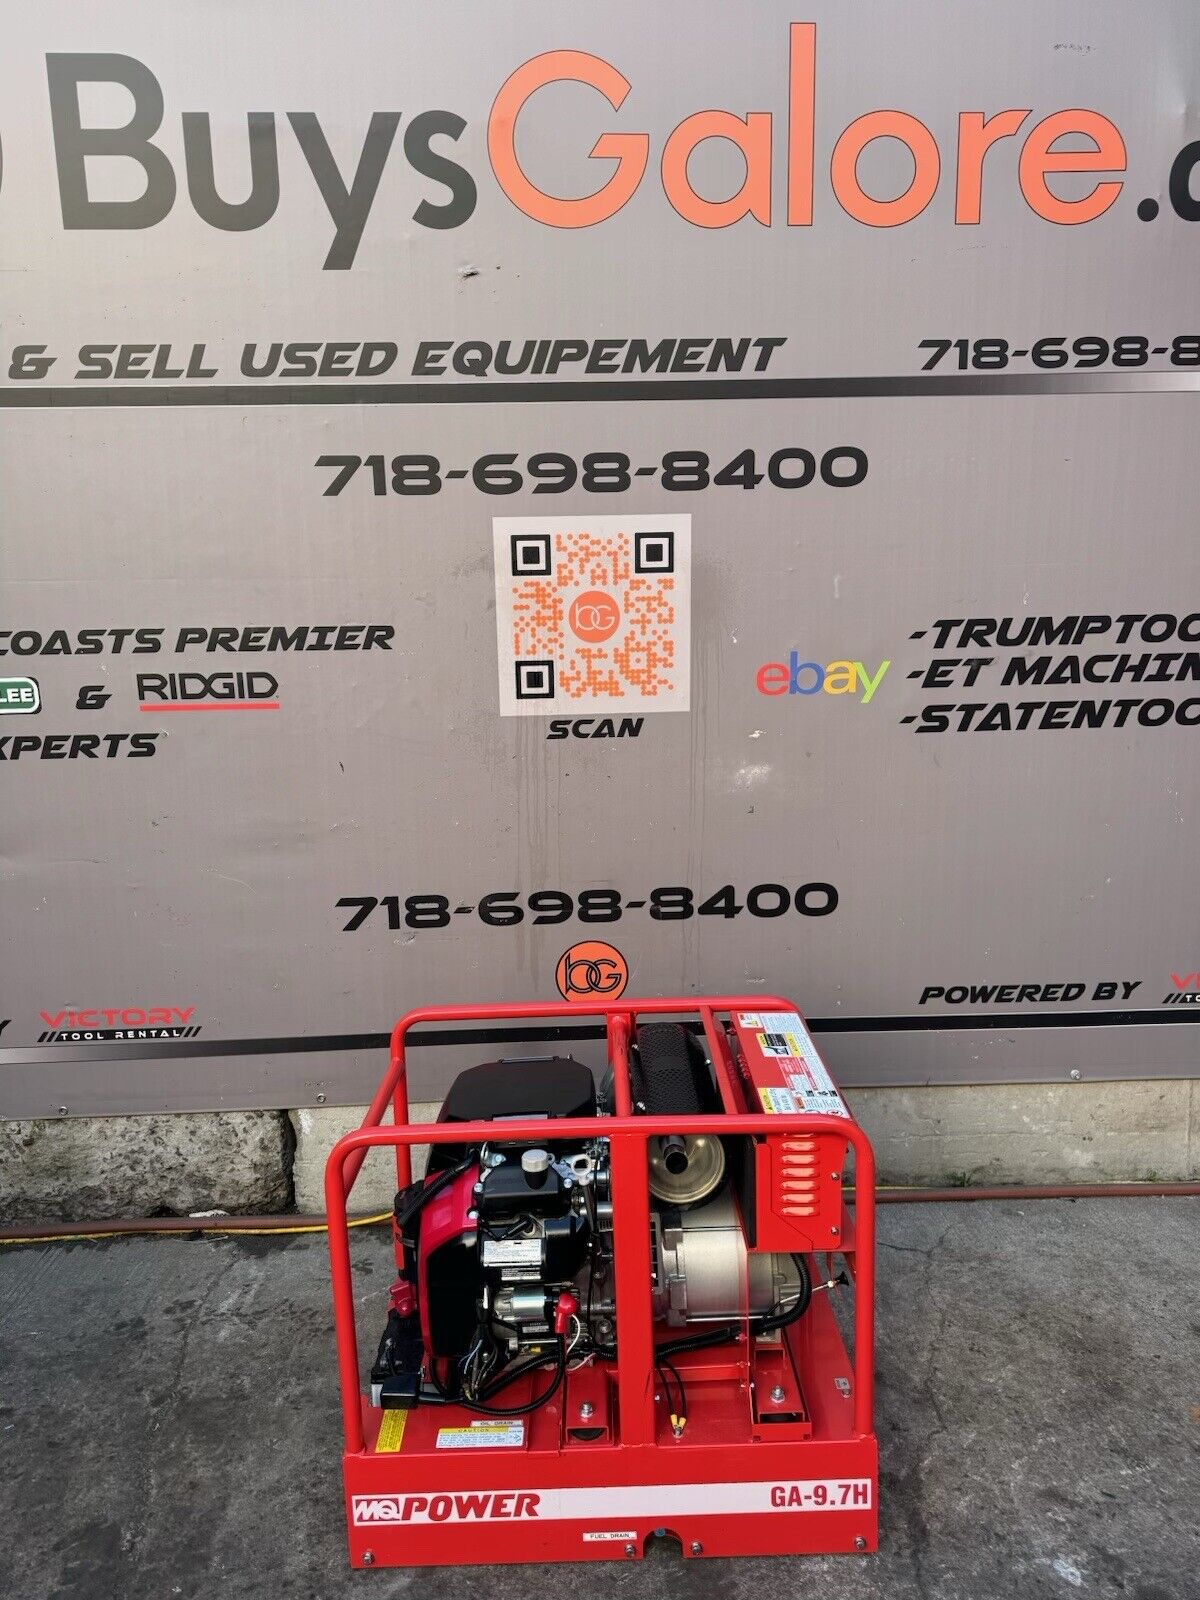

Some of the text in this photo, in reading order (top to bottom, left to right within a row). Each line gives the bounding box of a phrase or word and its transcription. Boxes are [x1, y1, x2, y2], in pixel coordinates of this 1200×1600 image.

[8, 337, 788, 379] & SELL USED EQUIPEMENT
[917, 336, 1200, 370] 718-698-8
[314, 446, 869, 497] 718-698-8400
[174, 625, 395, 653] PREMIER
[755, 651, 890, 703] ebay
[906, 657, 997, 688] -ET
[76, 672, 279, 710] & RIDGID
[546, 717, 645, 740] SCAN
[335, 882, 839, 932] 718-698-8400
[919, 981, 1143, 1005] POWERED BY
[40, 1007, 197, 1028] VICTORY
[61, 1029, 181, 1041] TOOL RENTAL
[354, 1493, 541, 1522] MQ POWER
[770, 1483, 869, 1508] GA-9.7H
